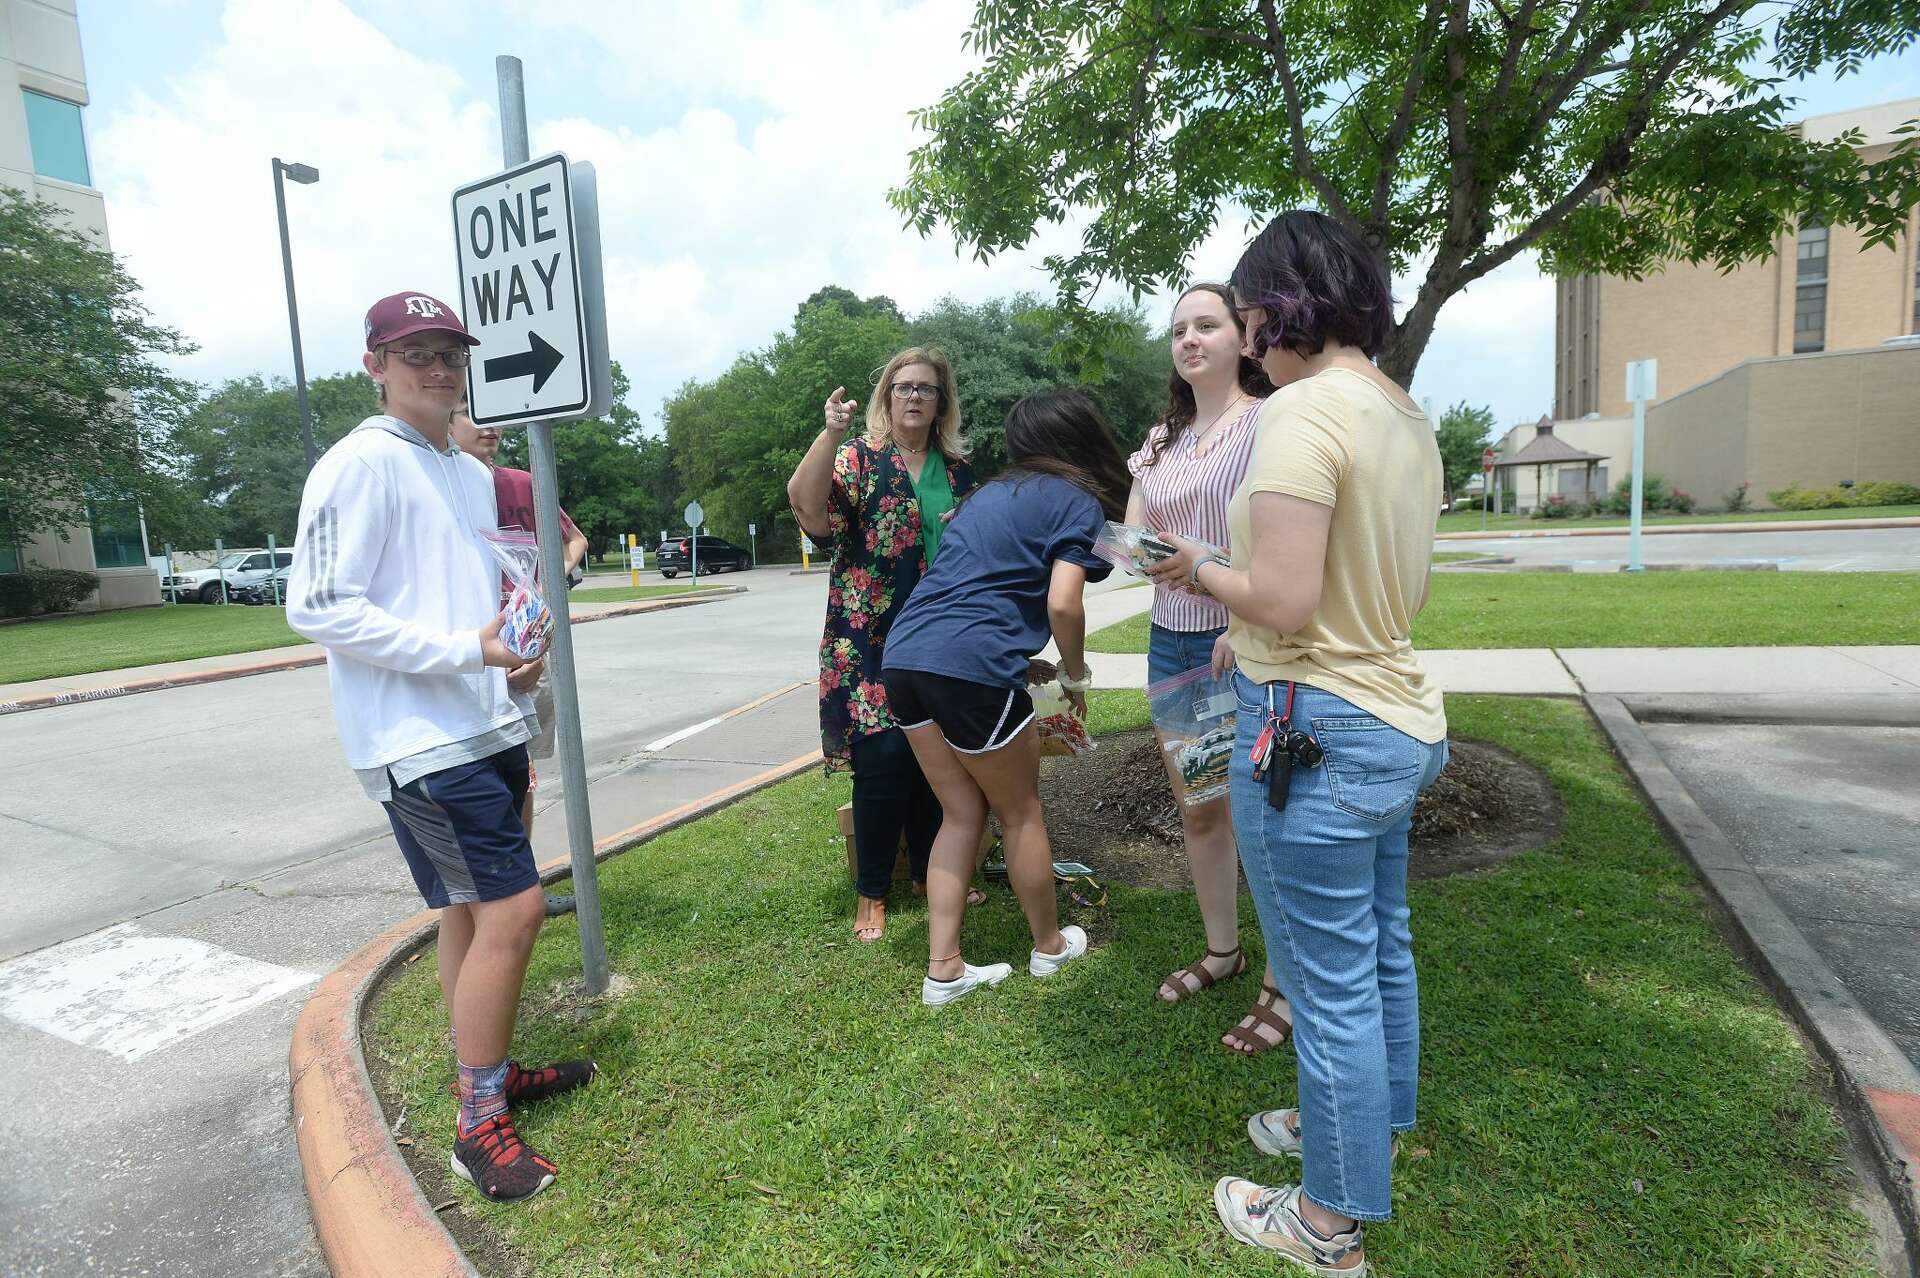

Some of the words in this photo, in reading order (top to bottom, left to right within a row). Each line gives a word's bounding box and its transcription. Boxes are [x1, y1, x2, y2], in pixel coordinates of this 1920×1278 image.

[470, 183, 556, 259] ONE
[471, 252, 561, 327] WAY
[55, 693, 72, 703] NO
[78, 686, 126, 701] PARKING
